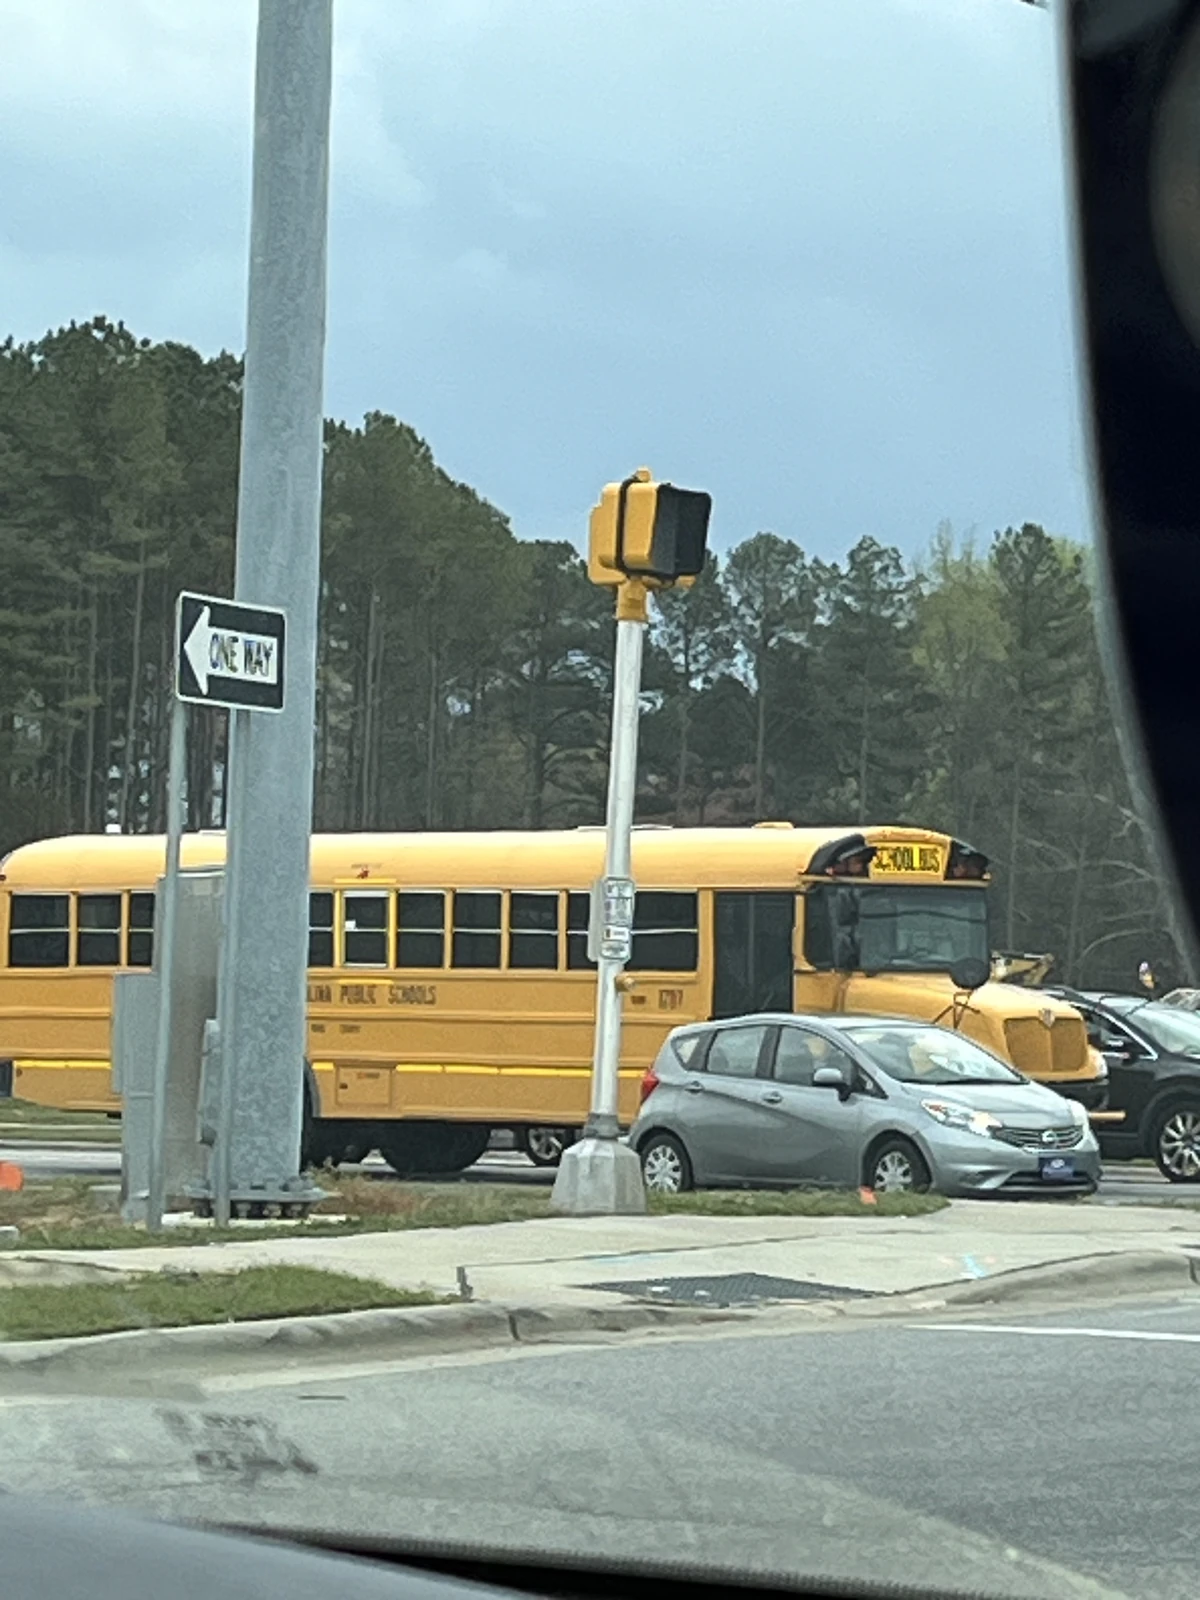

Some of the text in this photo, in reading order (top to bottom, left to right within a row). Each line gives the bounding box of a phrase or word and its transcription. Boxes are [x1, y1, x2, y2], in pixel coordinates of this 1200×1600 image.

[209, 633, 274, 677] ONE WAY
[874, 846, 941, 873] SCHOOL BUS
[307, 985, 437, 1005] LINA PUBLIC SCHOOLS
